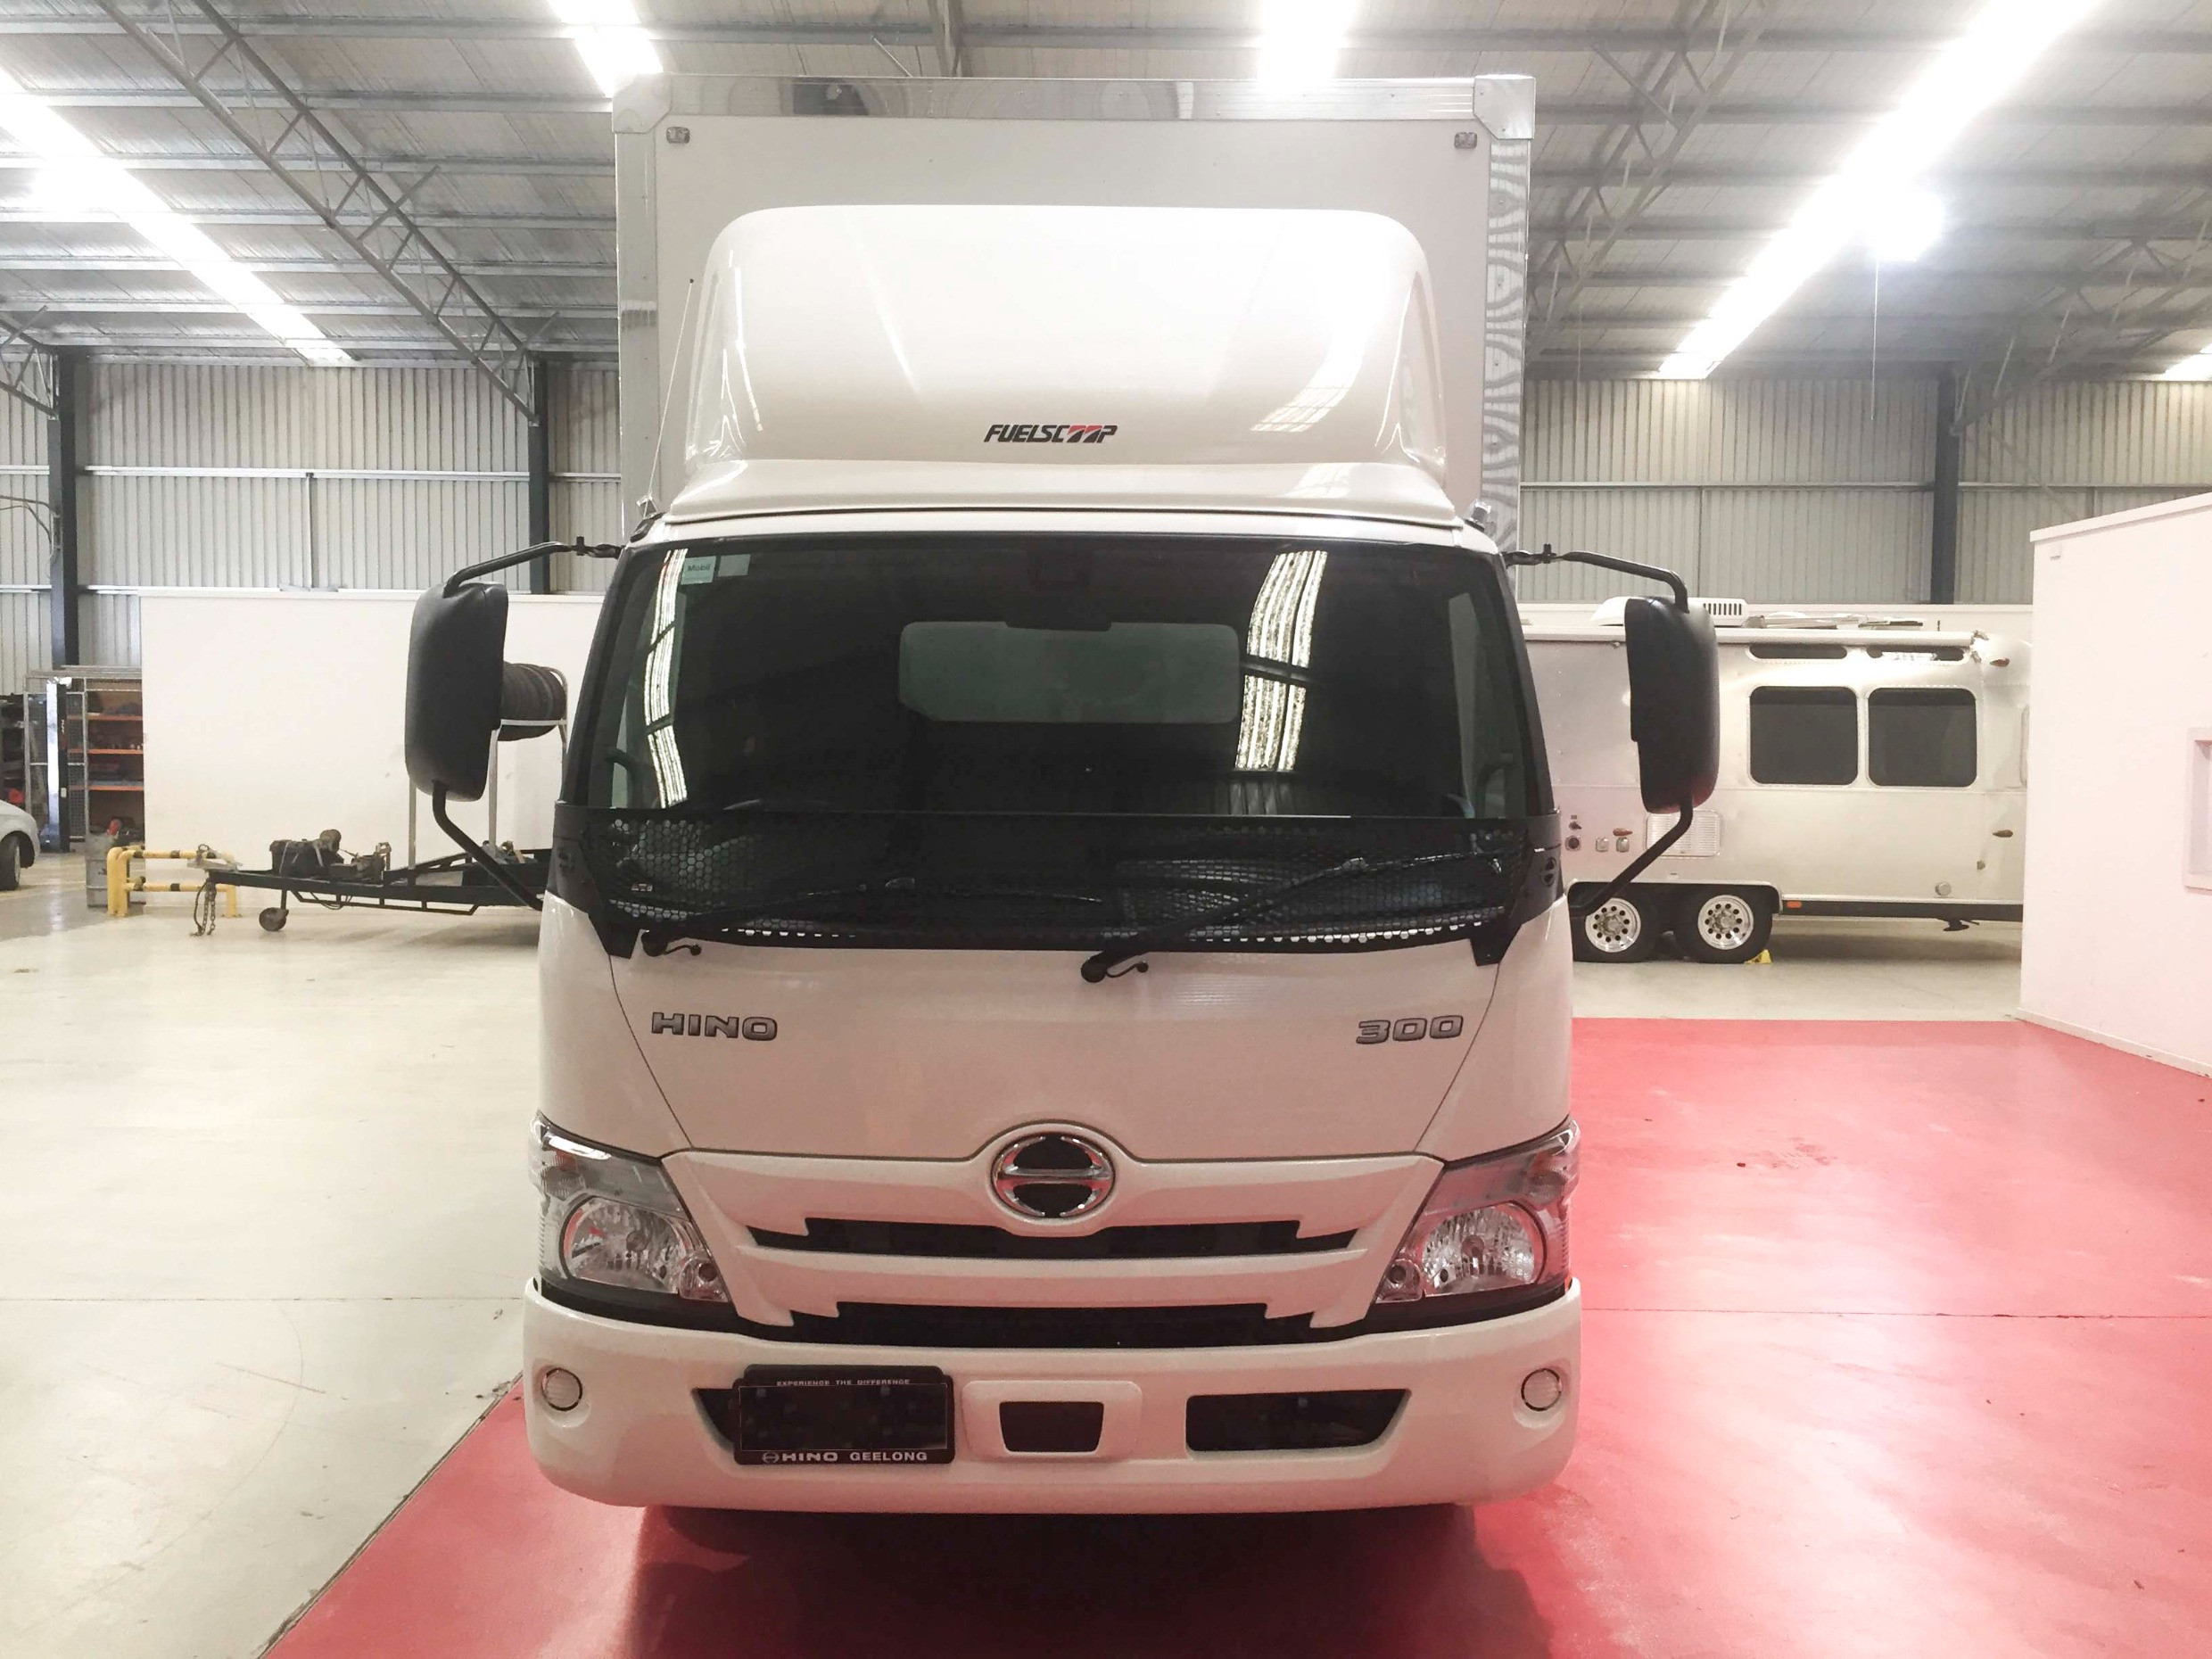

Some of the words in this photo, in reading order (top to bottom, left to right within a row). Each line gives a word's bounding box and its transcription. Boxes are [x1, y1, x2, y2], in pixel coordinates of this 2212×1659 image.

[983, 424, 1118, 443] FUELSCOOP
[651, 1011, 778, 1041] HINO
[1356, 1014, 1464, 1044] 300
[781, 1451, 839, 1462] HINO
[849, 1451, 928, 1462] GEELONG
